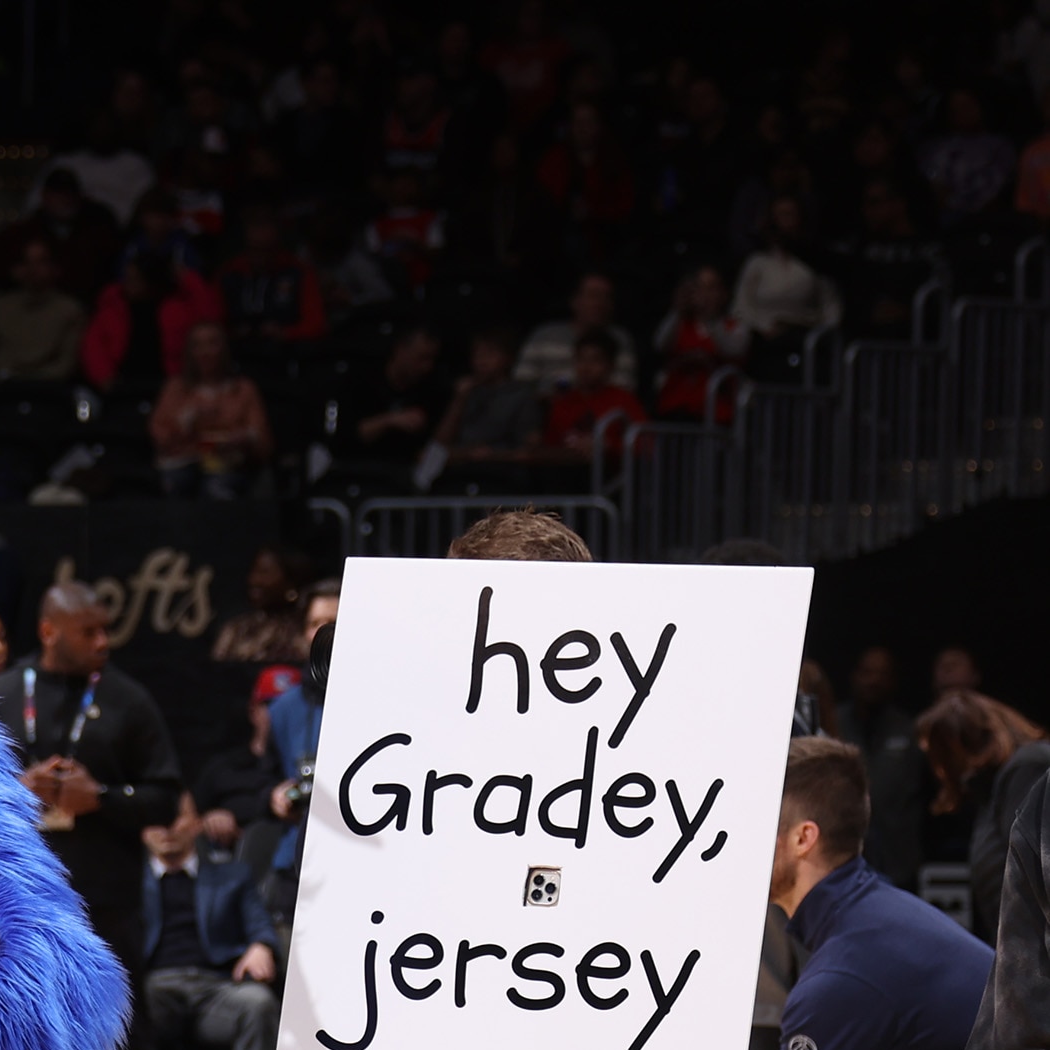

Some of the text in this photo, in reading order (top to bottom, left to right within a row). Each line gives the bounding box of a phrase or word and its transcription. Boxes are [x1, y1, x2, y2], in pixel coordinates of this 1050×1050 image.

[56, 549, 213, 648] ofts
[466, 586, 677, 749] hey
[338, 725, 728, 884] Gradey,
